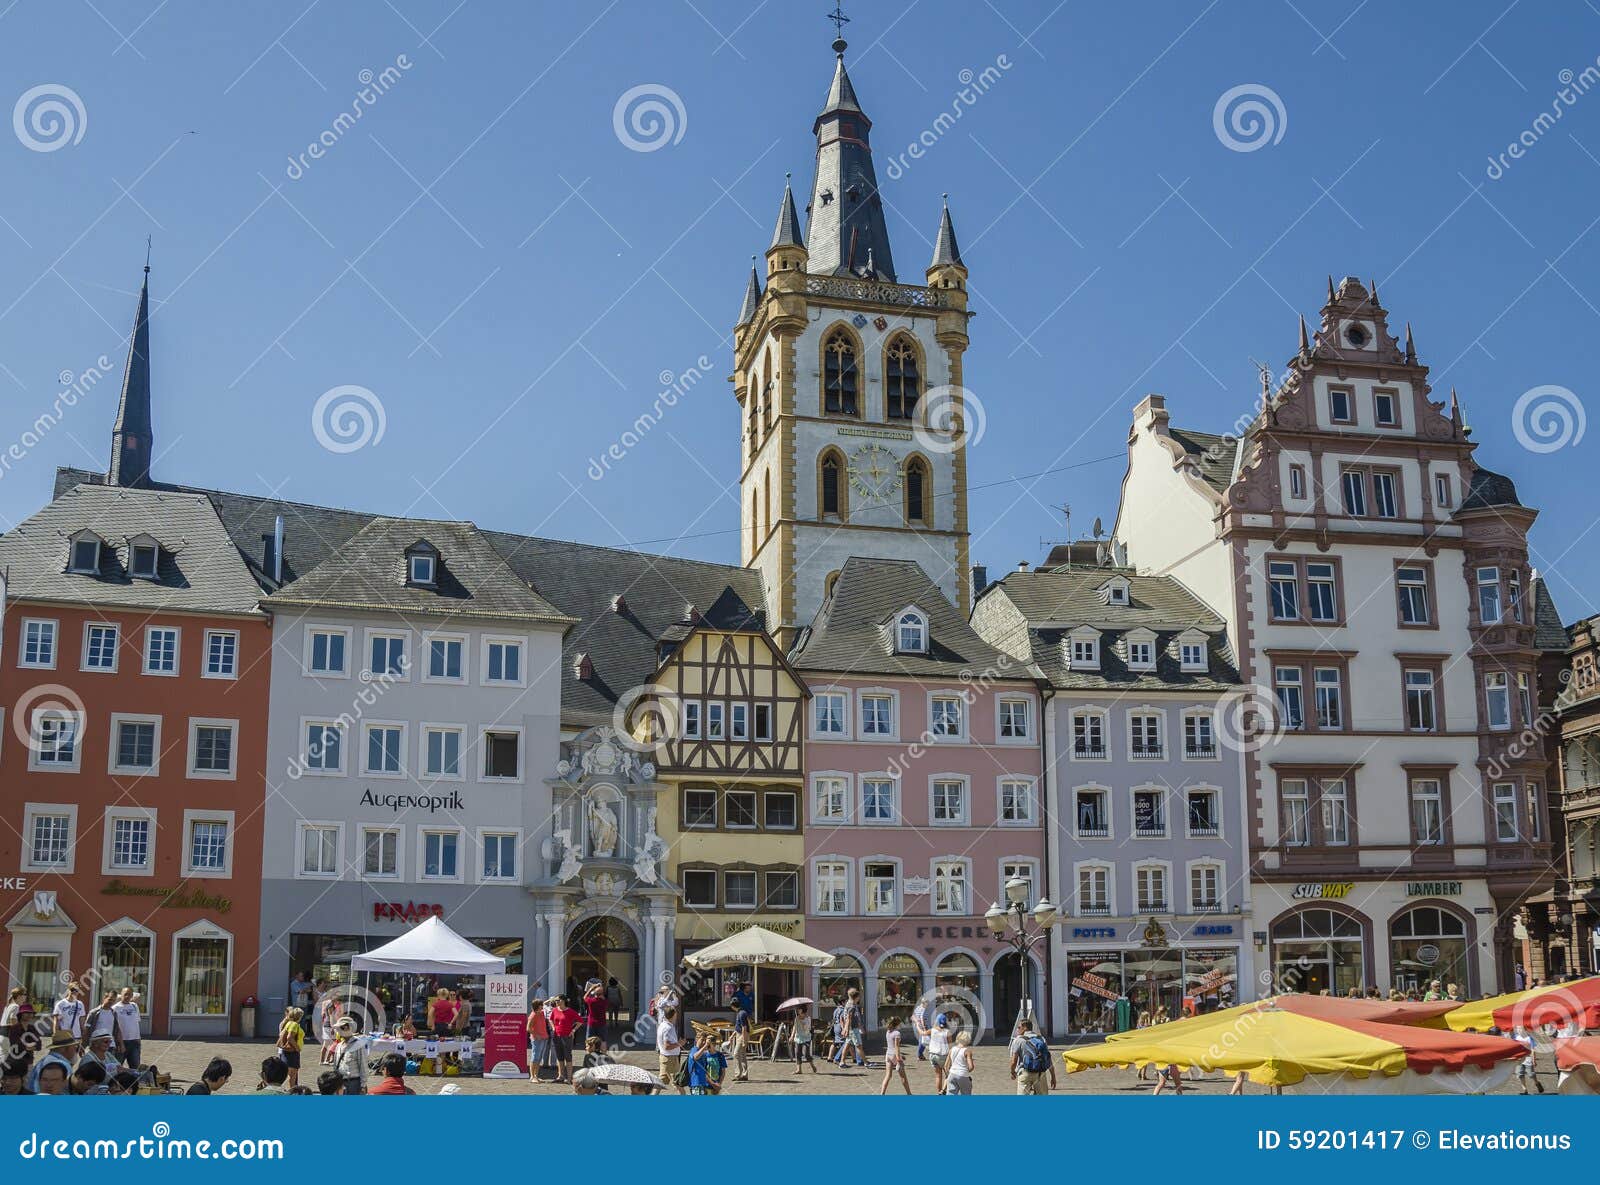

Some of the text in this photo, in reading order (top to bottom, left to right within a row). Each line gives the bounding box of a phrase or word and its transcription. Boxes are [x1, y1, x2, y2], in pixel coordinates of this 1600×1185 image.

[1292, 882, 1355, 899] SUBWAY
[1406, 881, 1463, 897] LAMBERT
[764, 921, 794, 932] HAUS
[1192, 925, 1233, 936] JEANS
[491, 981, 523, 993] PALAIS
